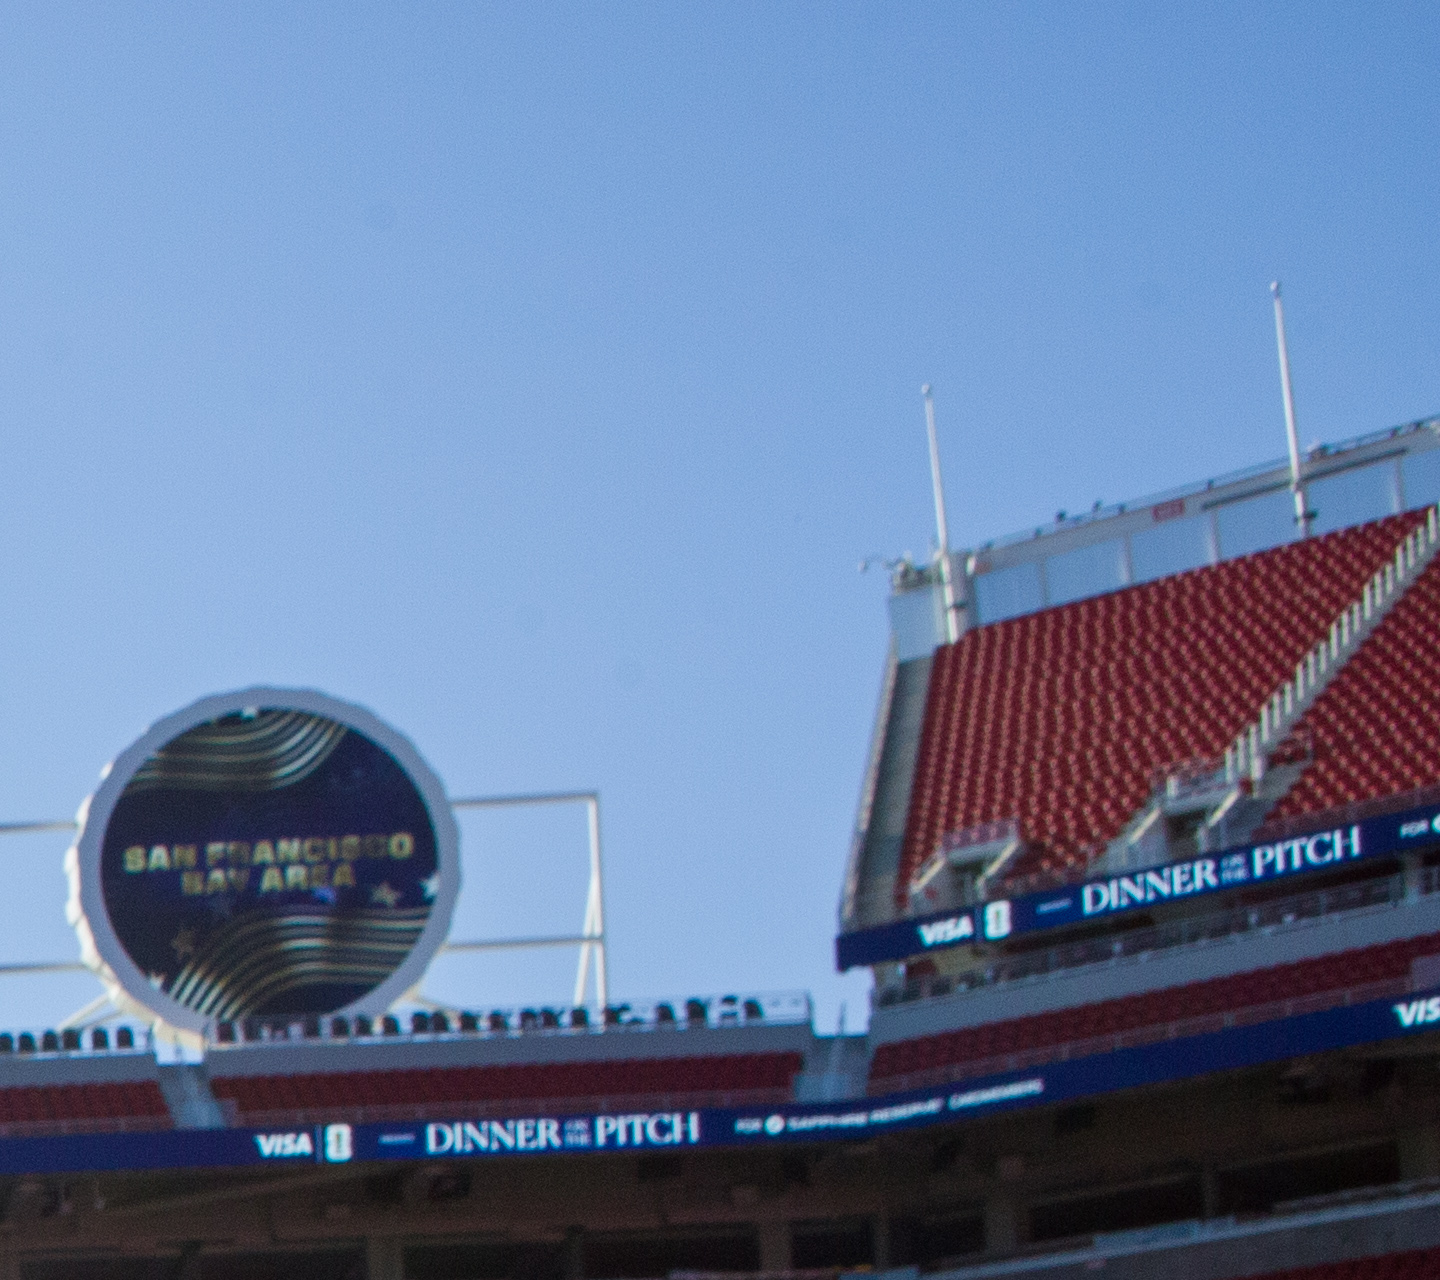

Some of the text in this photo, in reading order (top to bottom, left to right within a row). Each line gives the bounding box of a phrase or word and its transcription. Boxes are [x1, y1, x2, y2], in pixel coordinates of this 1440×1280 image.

[123, 844, 197, 873] SAN
[260, 864, 356, 892] AREA
[917, 914, 975, 949] VISA
[1081, 857, 1219, 917] DINNER
[1252, 826, 1362, 878] PITCH
[1391, 996, 1440, 1027] VIS
[255, 1133, 312, 1158] VISA
[426, 1118, 562, 1155] DINNER
[595, 1112, 699, 1147] PITCH
